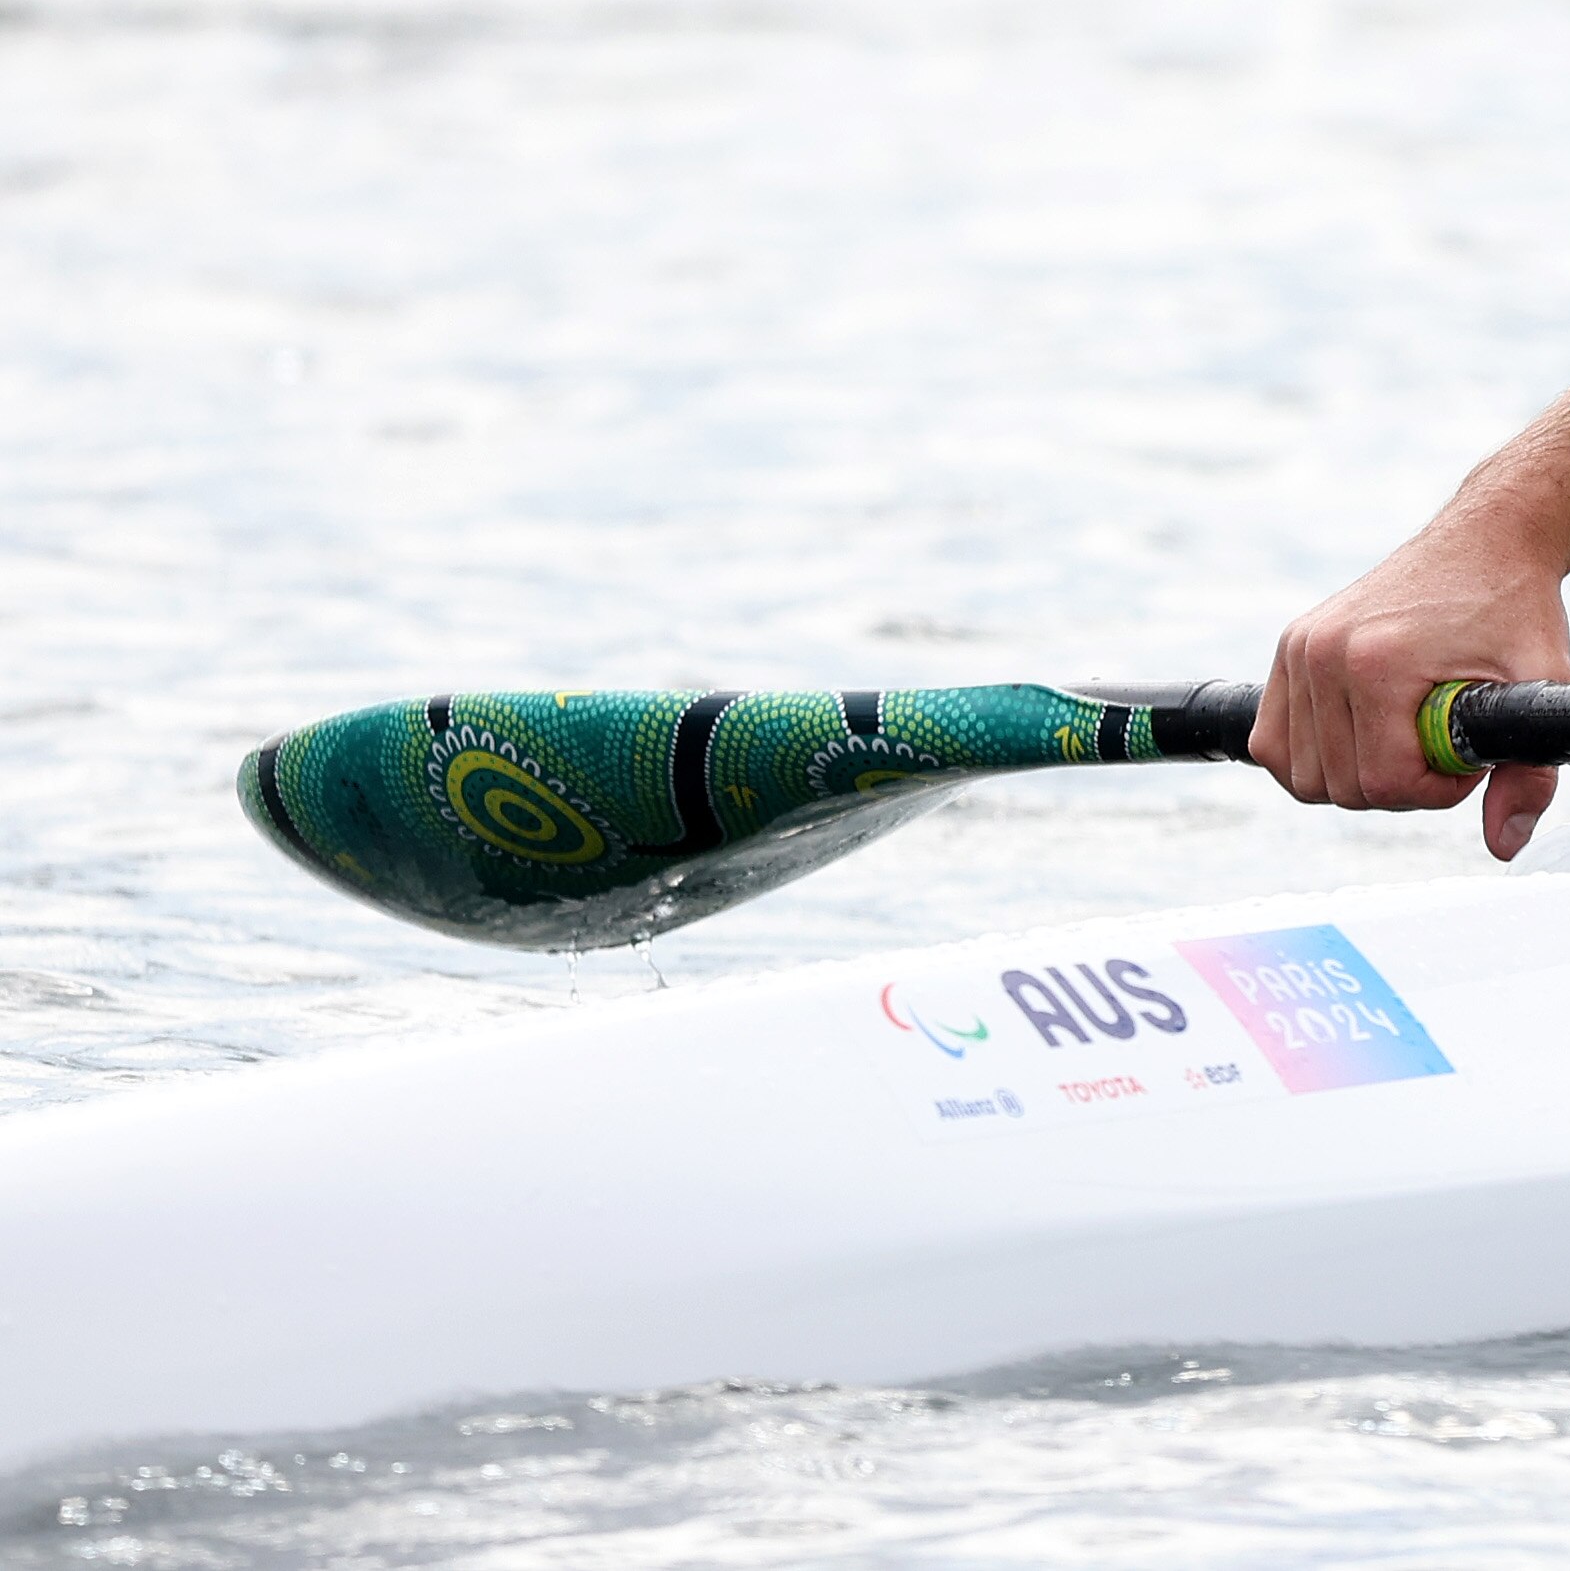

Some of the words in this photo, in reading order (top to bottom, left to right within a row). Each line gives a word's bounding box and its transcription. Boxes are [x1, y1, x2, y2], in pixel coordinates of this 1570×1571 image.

[1001, 959, 1187, 1048] AUS
[1265, 1001, 1400, 1049] 2024
[1057, 1076, 1148, 1103] TOYOTA
